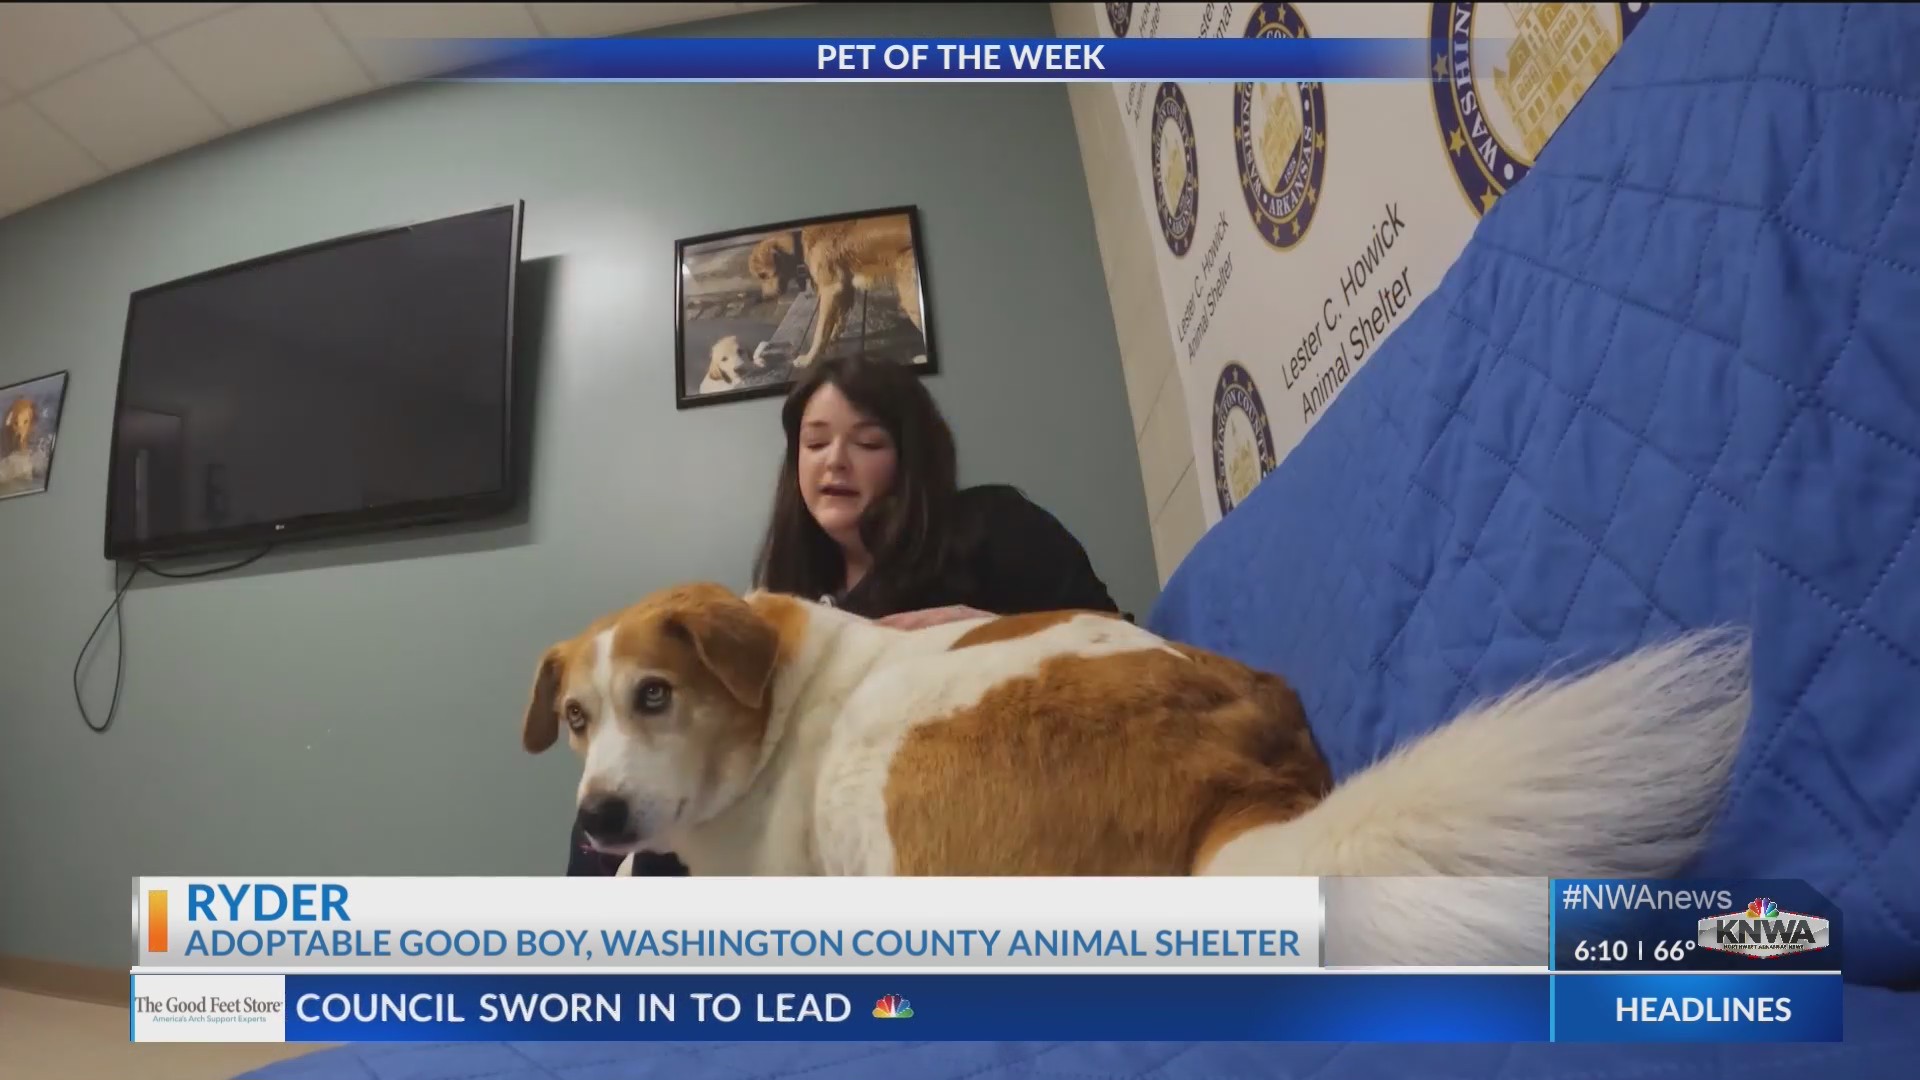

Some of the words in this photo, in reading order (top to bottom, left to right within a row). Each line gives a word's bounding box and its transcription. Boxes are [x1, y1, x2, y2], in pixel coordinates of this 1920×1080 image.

[1268, 126, 1312, 217] ARKANSAS
[1177, 293, 1196, 343] Lester
[1201, 210, 1229, 281] Howick
[1206, 252, 1233, 317] Shelter
[1281, 322, 1323, 390] Lester
[1323, 298, 1342, 331] C.
[1340, 202, 1405, 307] Howick
[1301, 342, 1351, 425] Animal
[1349, 266, 1412, 361] Shelter
